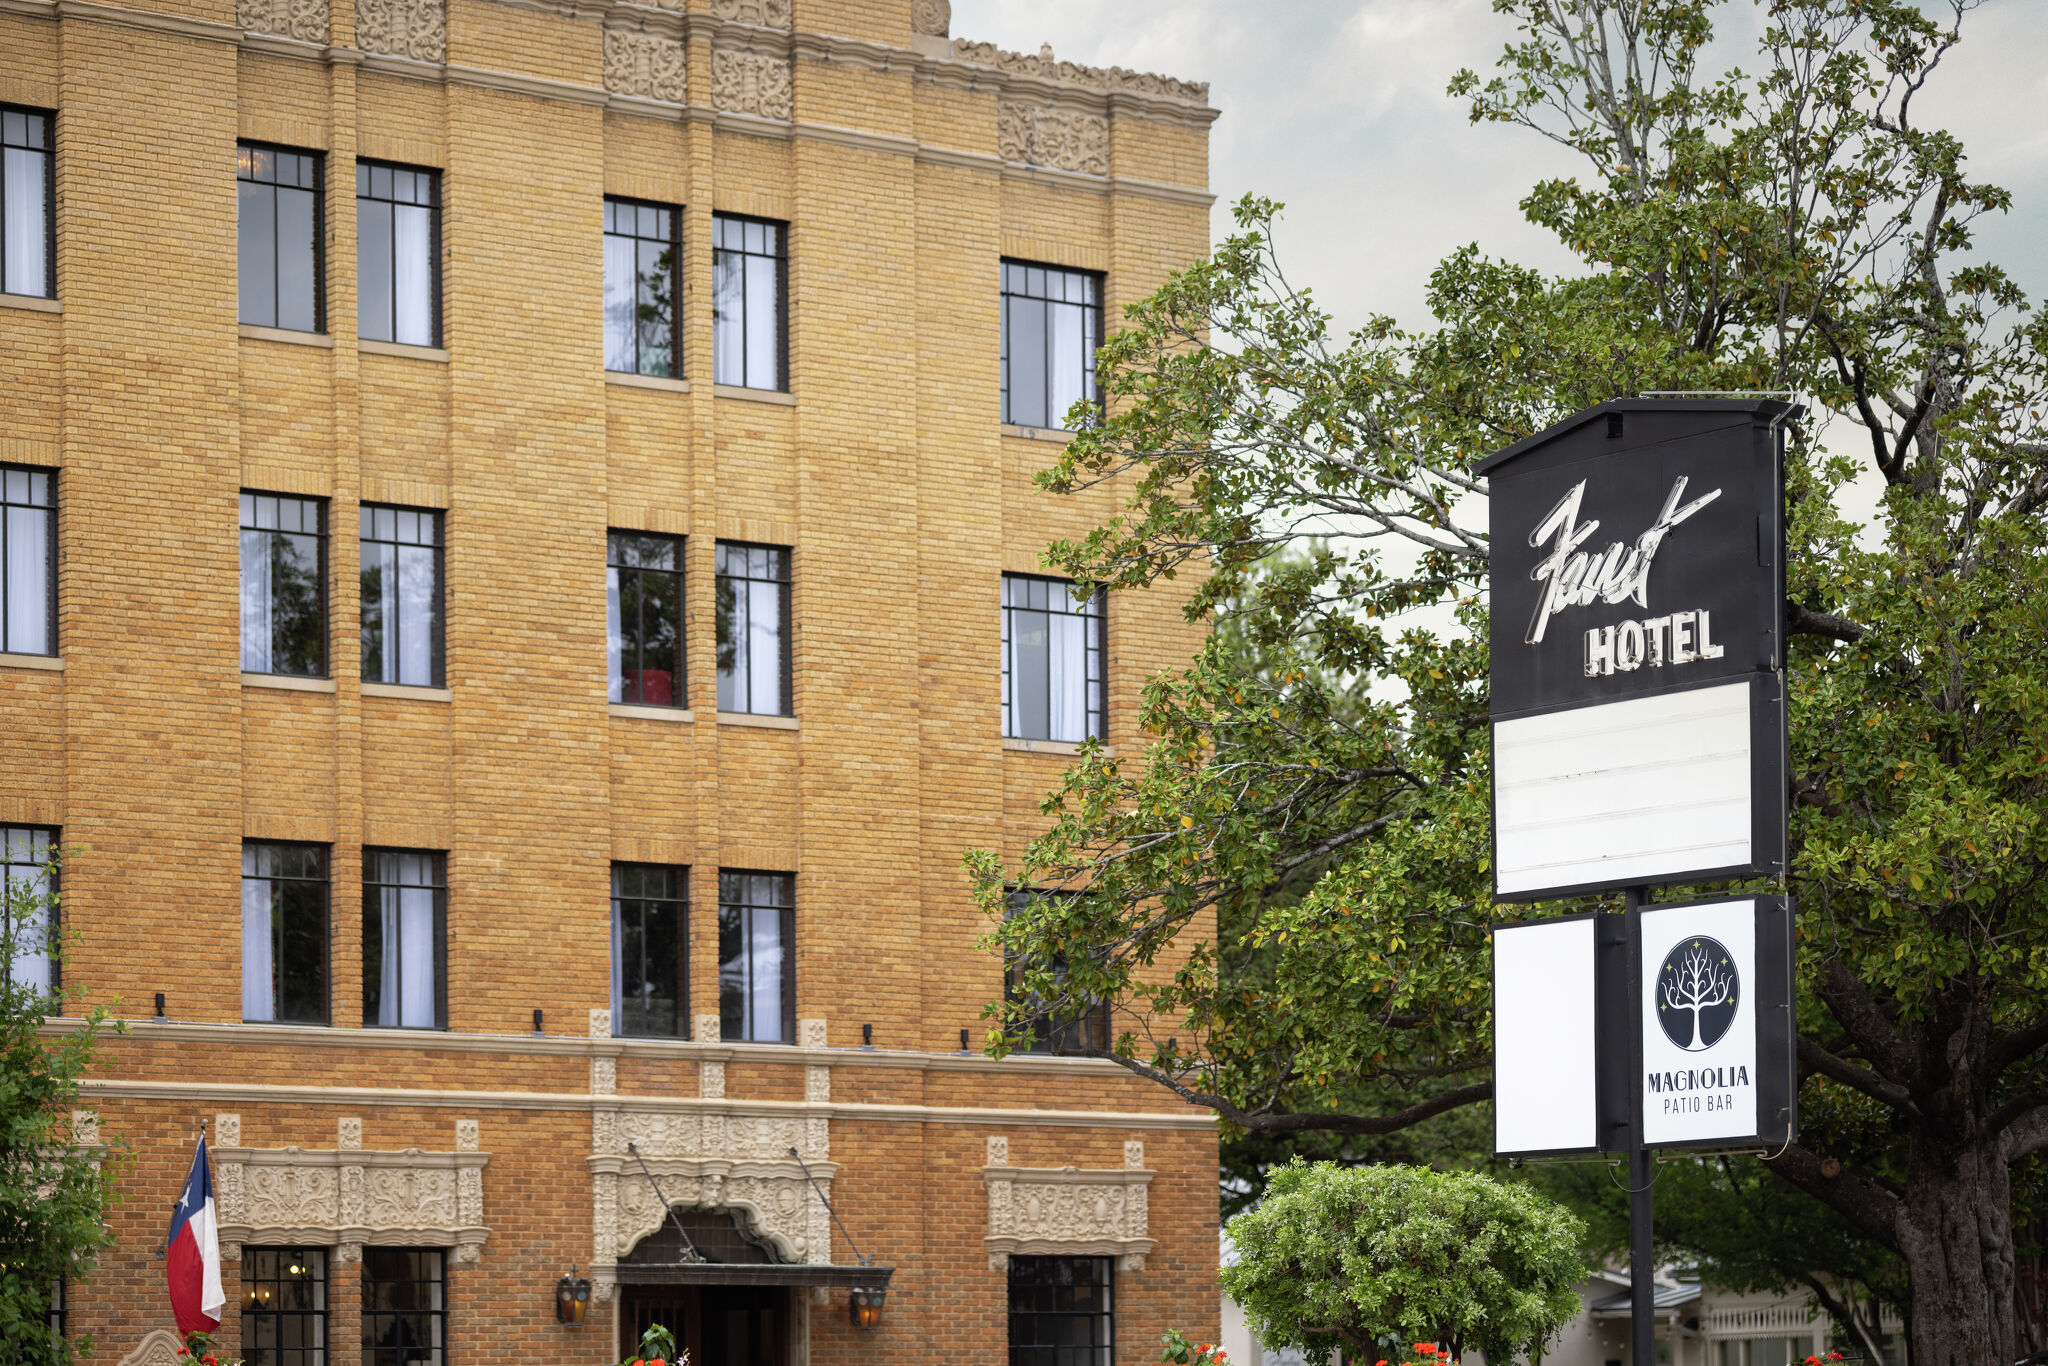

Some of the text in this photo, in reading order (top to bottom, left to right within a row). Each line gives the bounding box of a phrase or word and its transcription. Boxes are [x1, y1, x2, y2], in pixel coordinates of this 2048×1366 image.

[1584, 609, 1724, 678] HOTEL
[1648, 1065, 1749, 1093] MAGNOLIA
[1664, 1094, 1733, 1115] PATIO BAR
